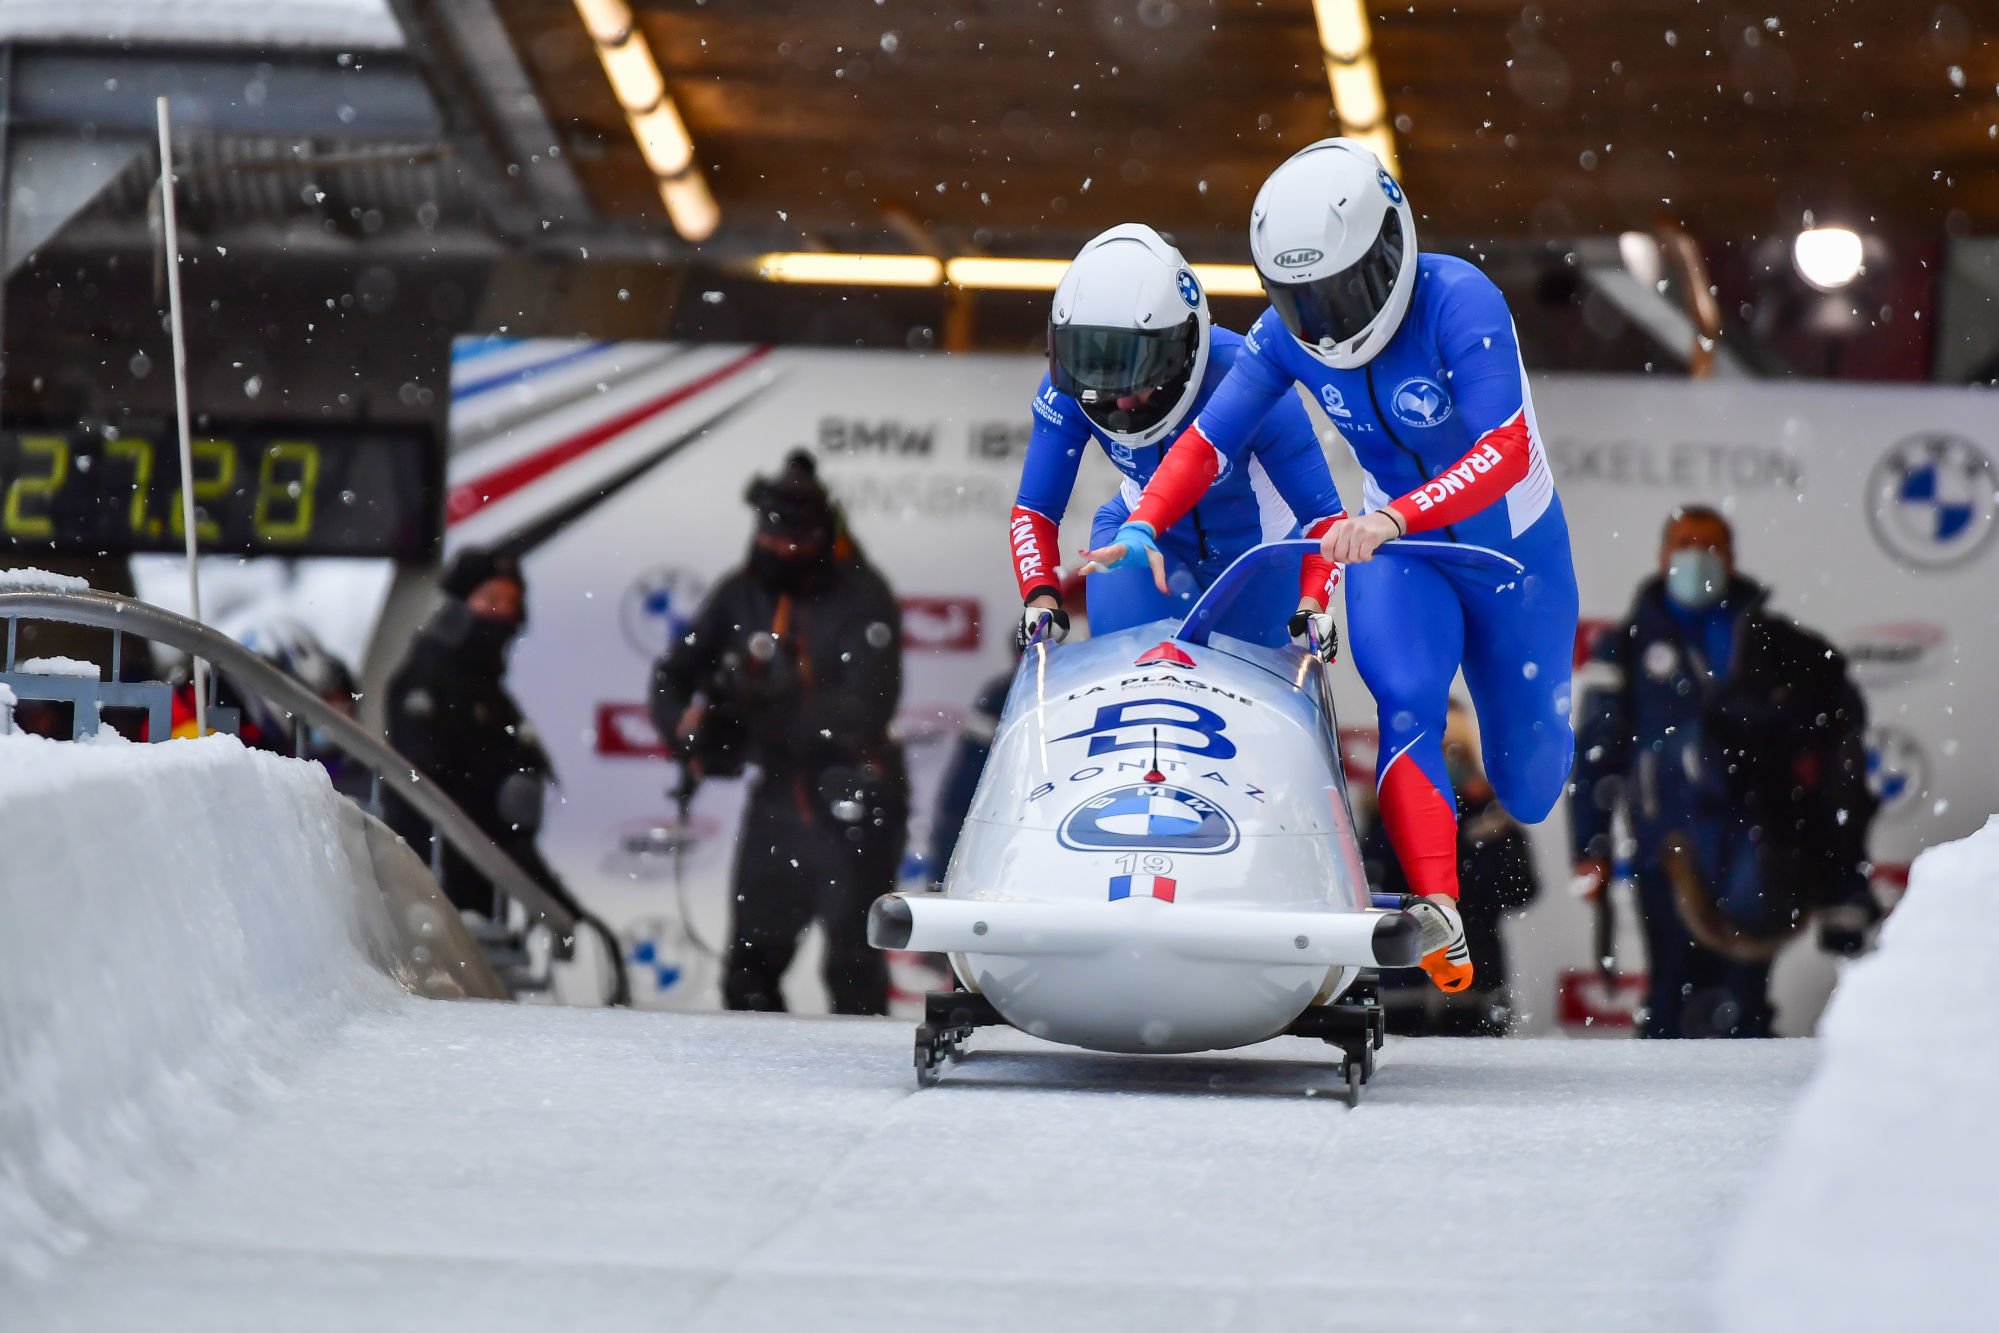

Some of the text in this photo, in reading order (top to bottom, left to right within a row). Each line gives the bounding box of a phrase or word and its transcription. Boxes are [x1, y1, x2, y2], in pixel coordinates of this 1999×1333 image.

[1280, 250, 1317, 265] HJC
[1409, 443, 1503, 512] FRANCE
[1550, 436, 1806, 488] SKELETON
[1068, 675, 1253, 706] LA PLAGNE
[1025, 759, 1265, 803] BONTAZ
[1087, 786, 1216, 813] BMW
[1115, 853, 1174, 875] 19
